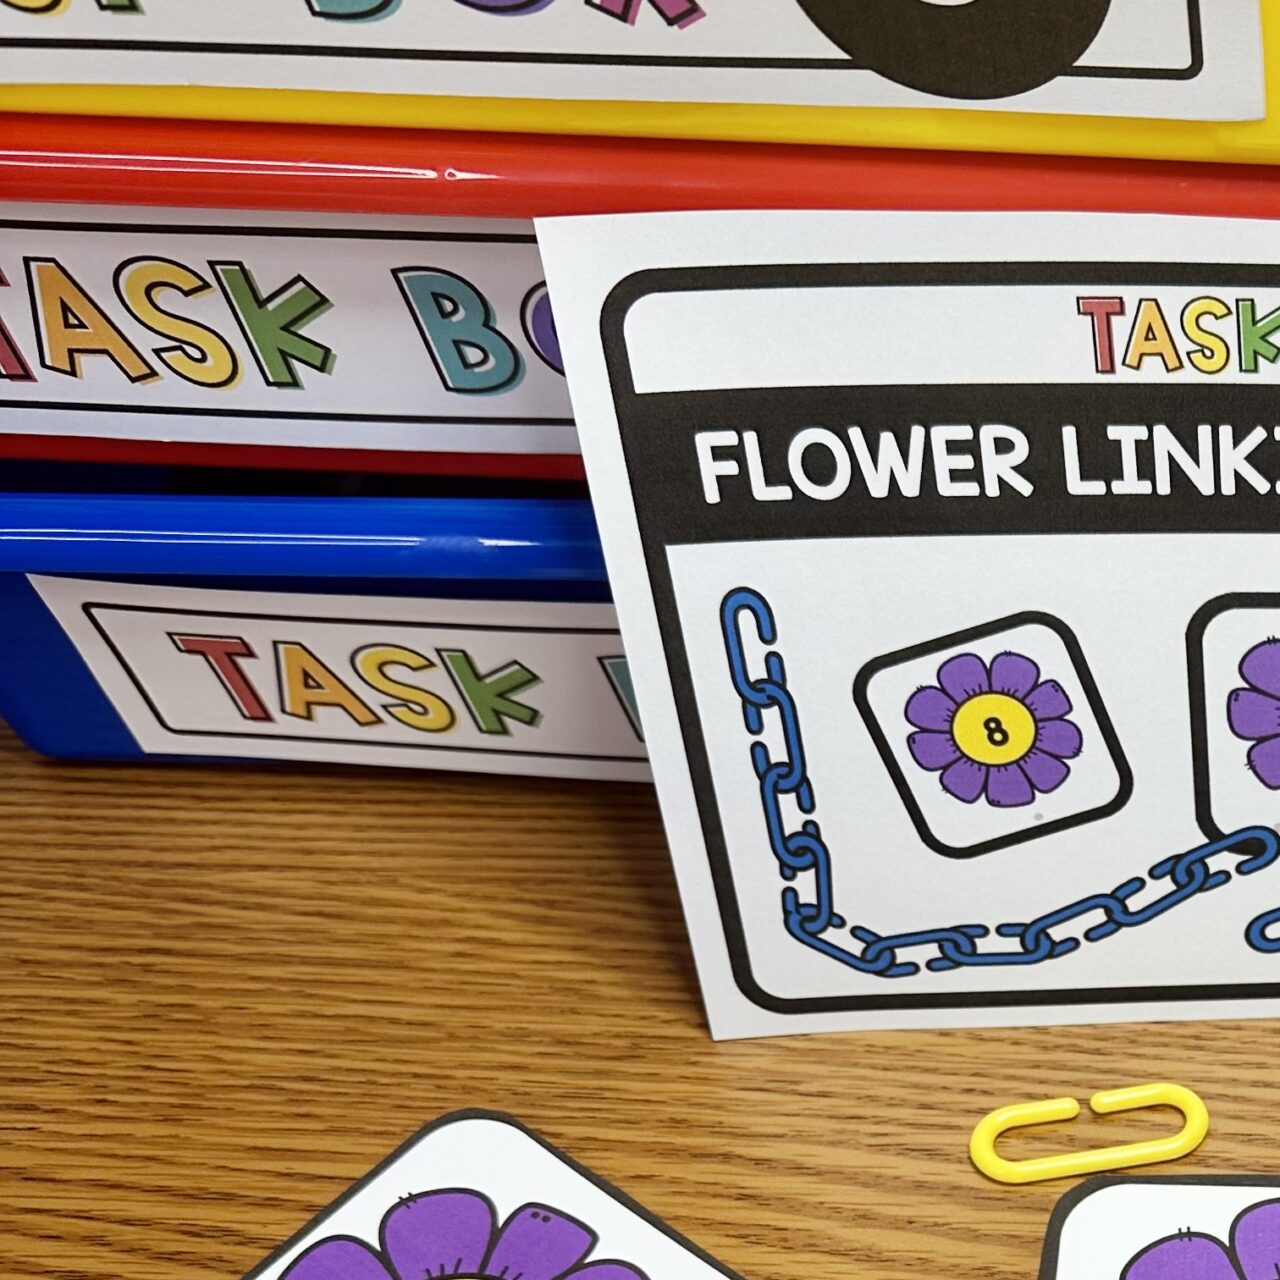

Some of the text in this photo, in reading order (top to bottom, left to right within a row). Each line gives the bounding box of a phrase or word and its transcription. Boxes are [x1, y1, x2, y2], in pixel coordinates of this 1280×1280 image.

[695, 424, 1034, 504] FLOWER
[167, 632, 541, 736] TASK
[982, 716, 1010, 747] 8
